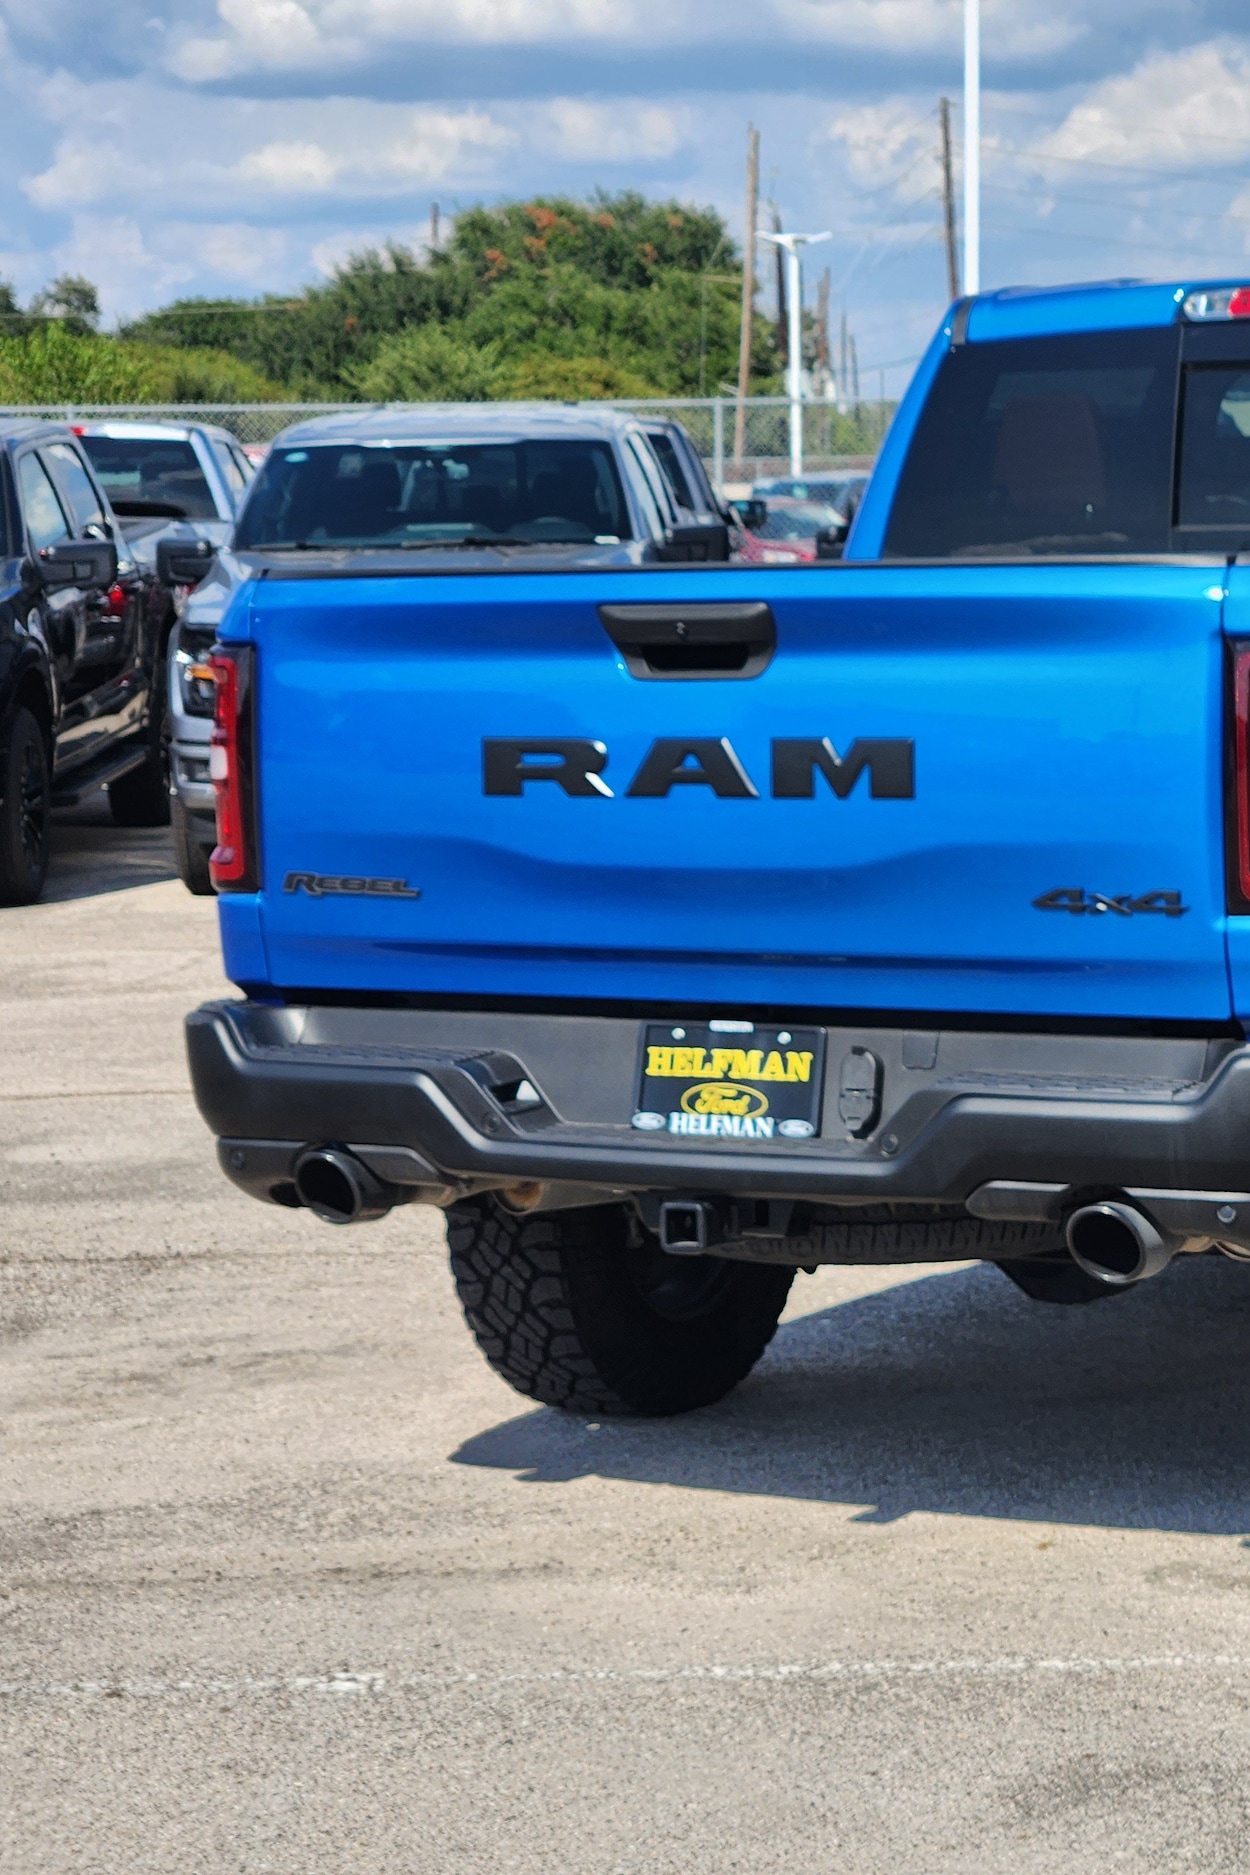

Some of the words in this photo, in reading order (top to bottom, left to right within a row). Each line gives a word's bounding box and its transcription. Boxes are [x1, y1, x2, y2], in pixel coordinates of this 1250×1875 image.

[483, 736, 916, 799] RAM
[282, 870, 421, 897] REBEL
[645, 1046, 814, 1082] HELFMAN
[695, 1087, 751, 1115] Ford
[669, 1111, 775, 1138] HELFMAN
